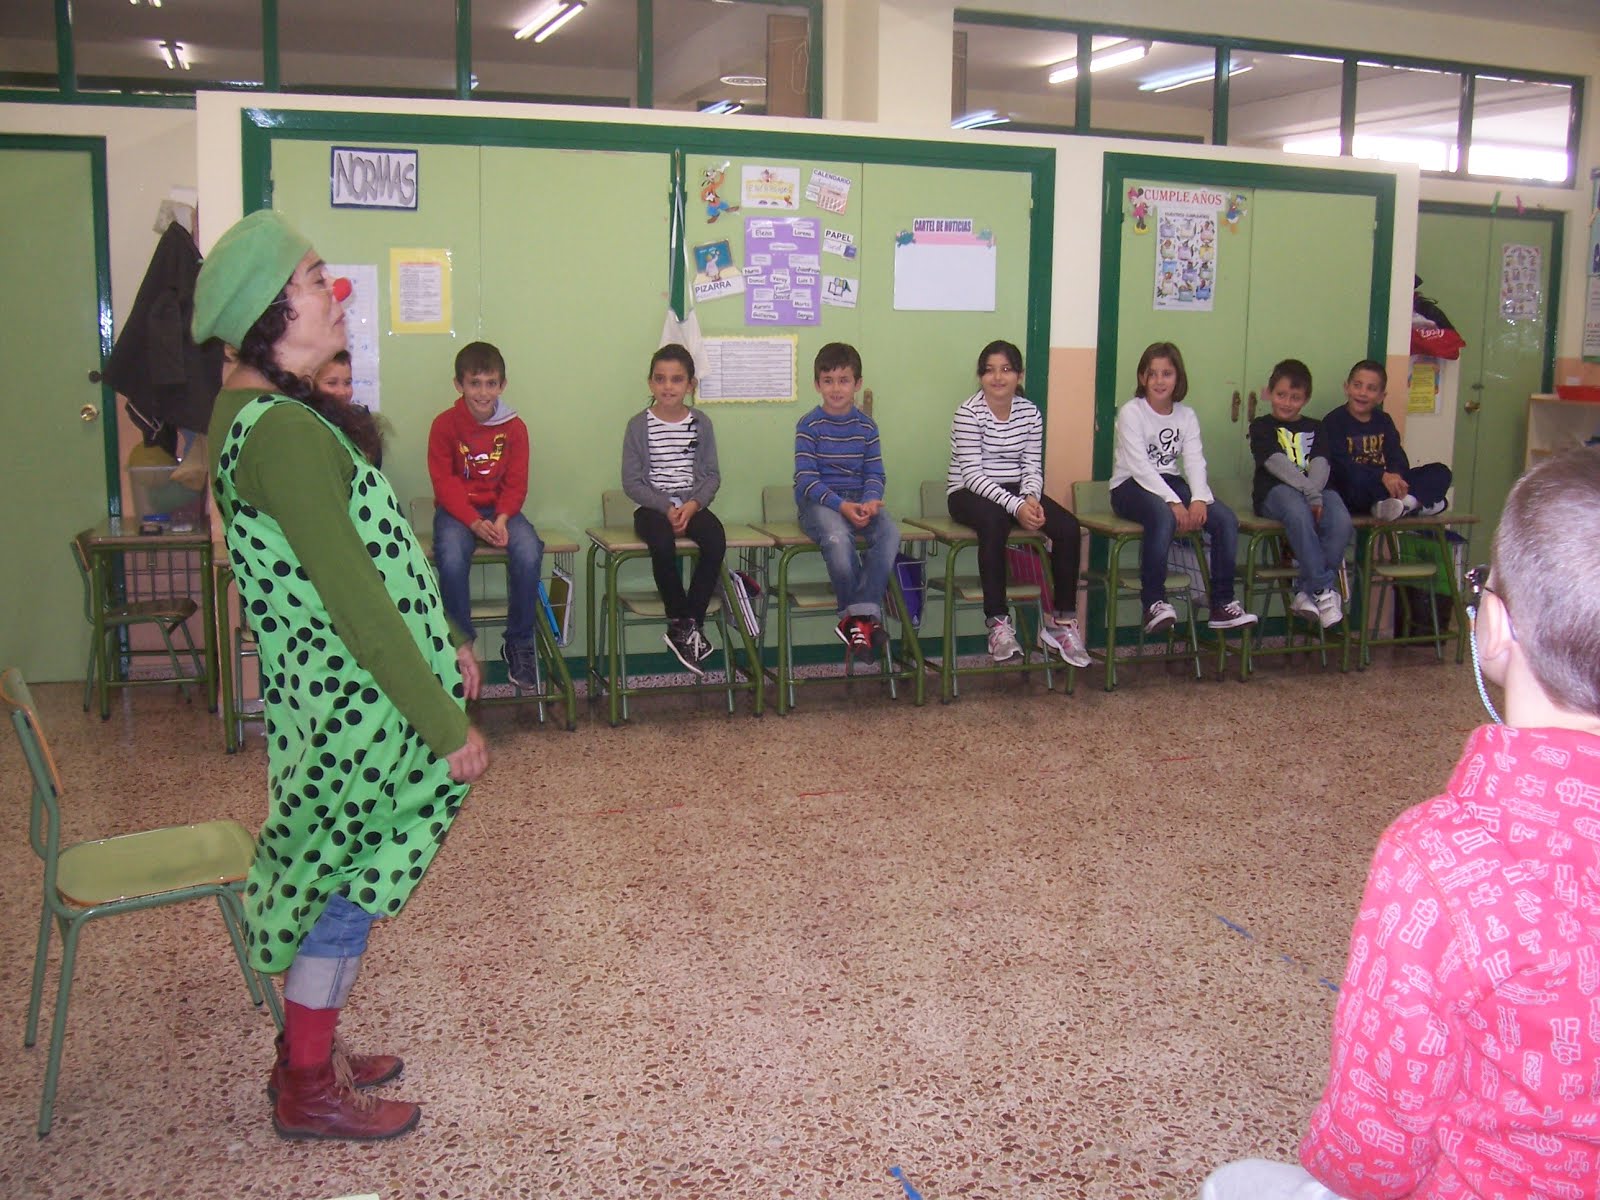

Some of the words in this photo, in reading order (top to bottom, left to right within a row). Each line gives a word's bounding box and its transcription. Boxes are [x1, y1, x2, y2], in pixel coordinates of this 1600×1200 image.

[335, 152, 415, 206] NORMAS
[813, 169, 851, 185] CALENDARIO
[914, 220, 935, 232] CARTEL
[936, 220, 944, 232] DE
[944, 220, 972, 233] NOTICIAS
[825, 230, 852, 243] PAPEL
[695, 280, 732, 293] PIZARRA
